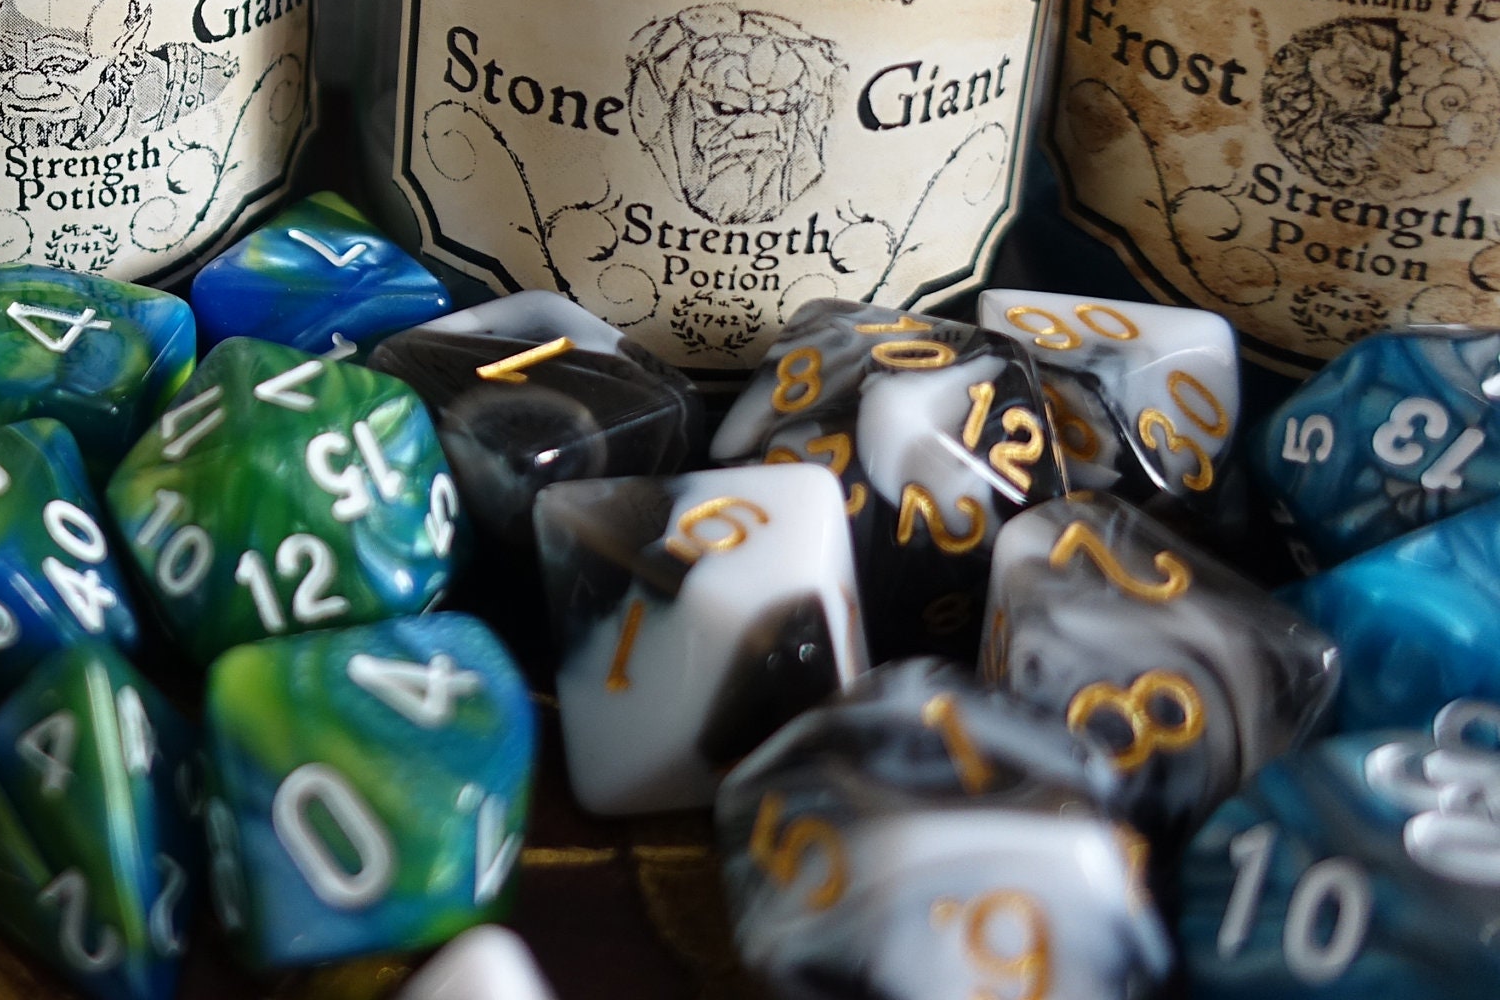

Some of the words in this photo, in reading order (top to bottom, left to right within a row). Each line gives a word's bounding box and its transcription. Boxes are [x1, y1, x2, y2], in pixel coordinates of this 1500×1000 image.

[442, 25, 627, 138] Stone
[855, 52, 1012, 134] Giant
[3, 133, 161, 187] Strength
[16, 176, 142, 213] Potion
[619, 200, 833, 271] Strength
[1245, 162, 1486, 250] Strength
[62, 240, 103, 255] 1742
[660, 255, 781, 293] Potion
[1265, 215, 1430, 284] Potion
[5, 300, 113, 354] 4
[691, 311, 741, 329] 1742
[771, 346, 823, 413] 8
[961, 380, 1045, 495] 12
[1281, 413, 1335, 464] 5
[40, 498, 122, 634] 40
[135, 488, 216, 596] 10
[1049, 520, 1192, 602] 2
[234, 532, 352, 634] 12
[347, 652, 484, 729] 4
[1066, 669, 1205, 771] 8
[271, 762, 396, 911] 0
[1215, 818, 1374, 985] 10
